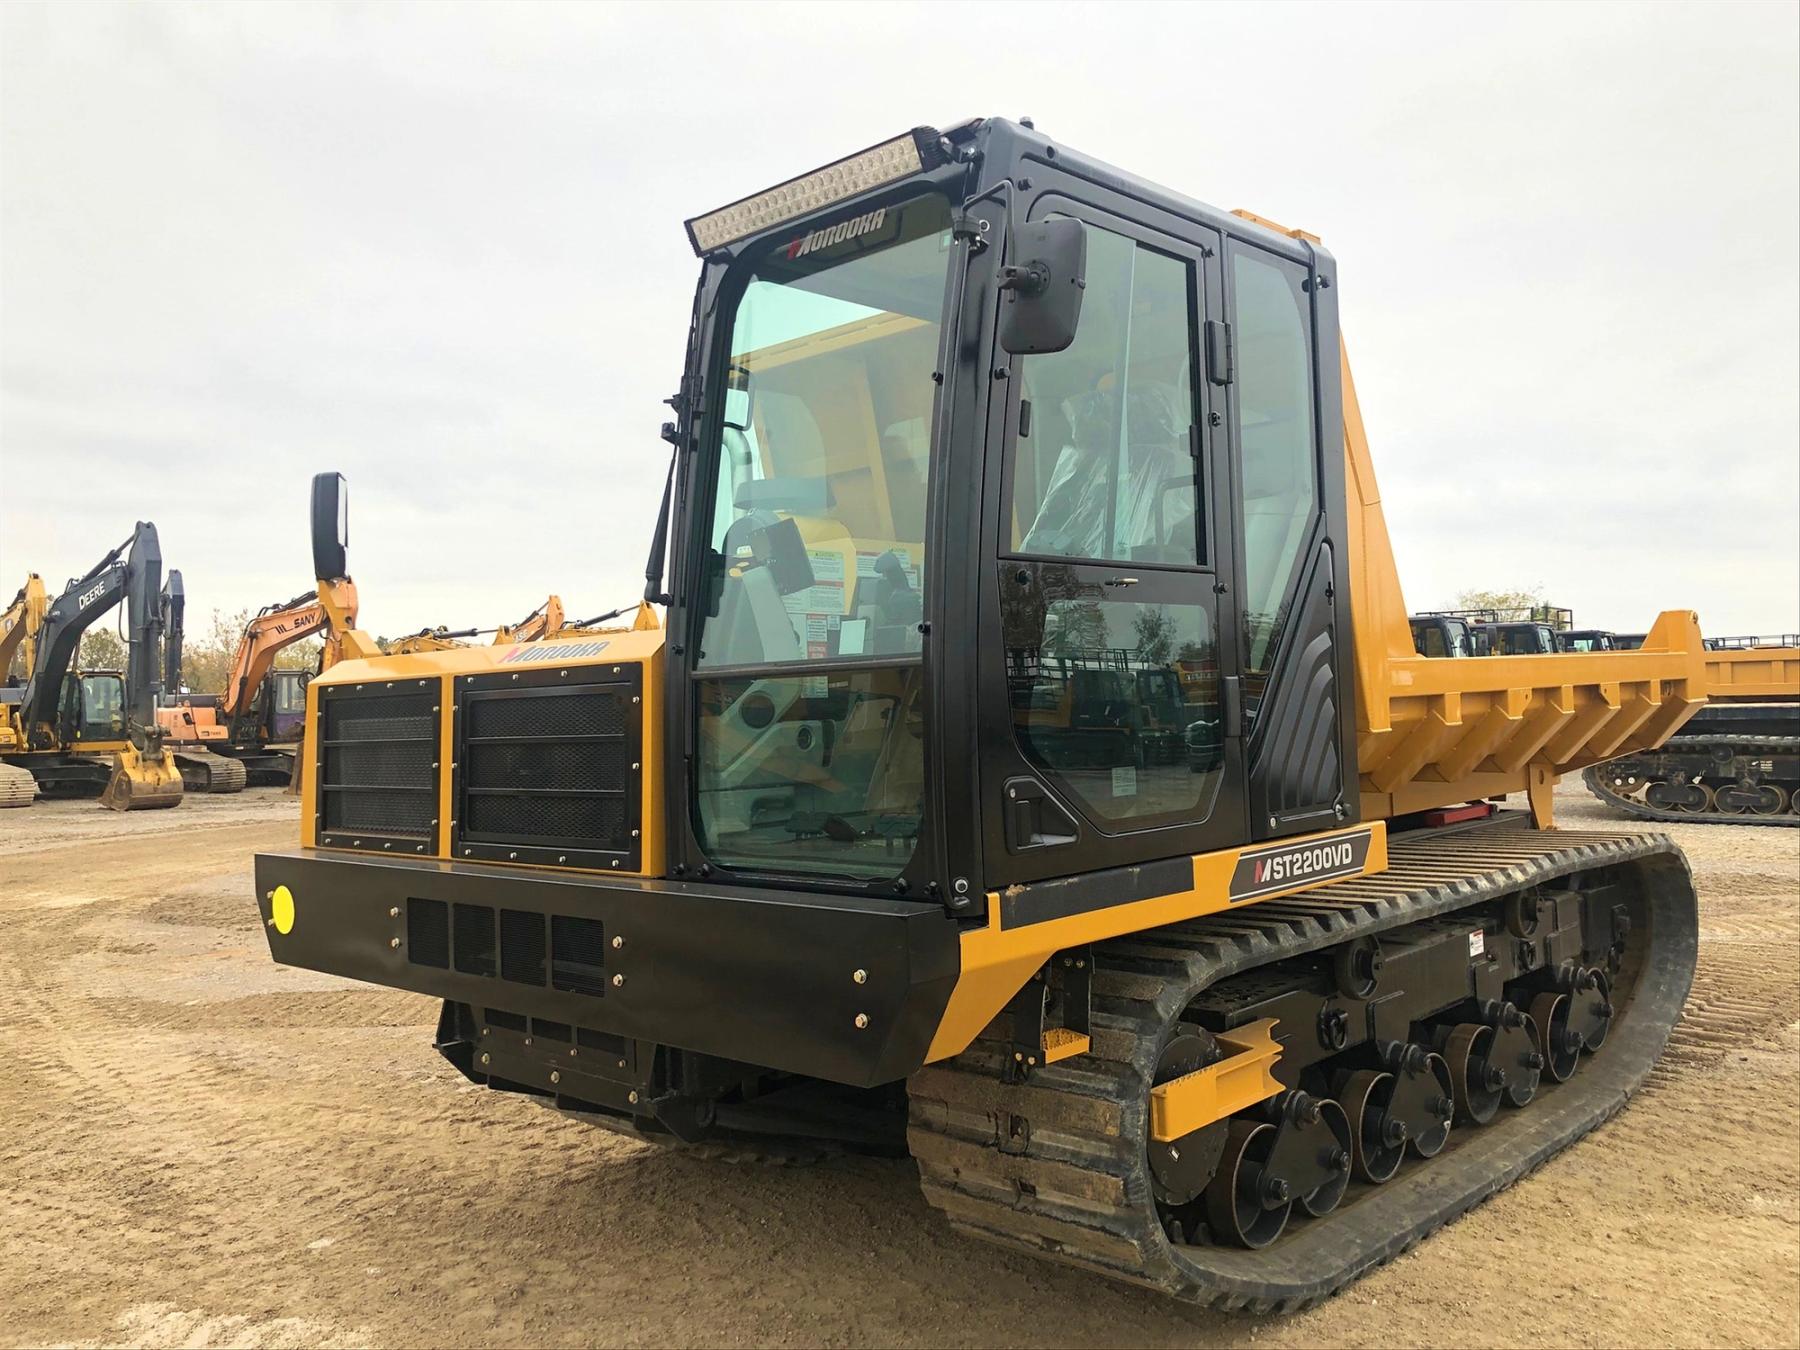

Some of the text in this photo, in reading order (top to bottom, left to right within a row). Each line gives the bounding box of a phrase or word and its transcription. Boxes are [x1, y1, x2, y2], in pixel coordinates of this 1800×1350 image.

[78, 580, 106, 611] DEERE
[293, 612, 316, 629] SANY
[1254, 842, 1353, 884] MST2200VD
